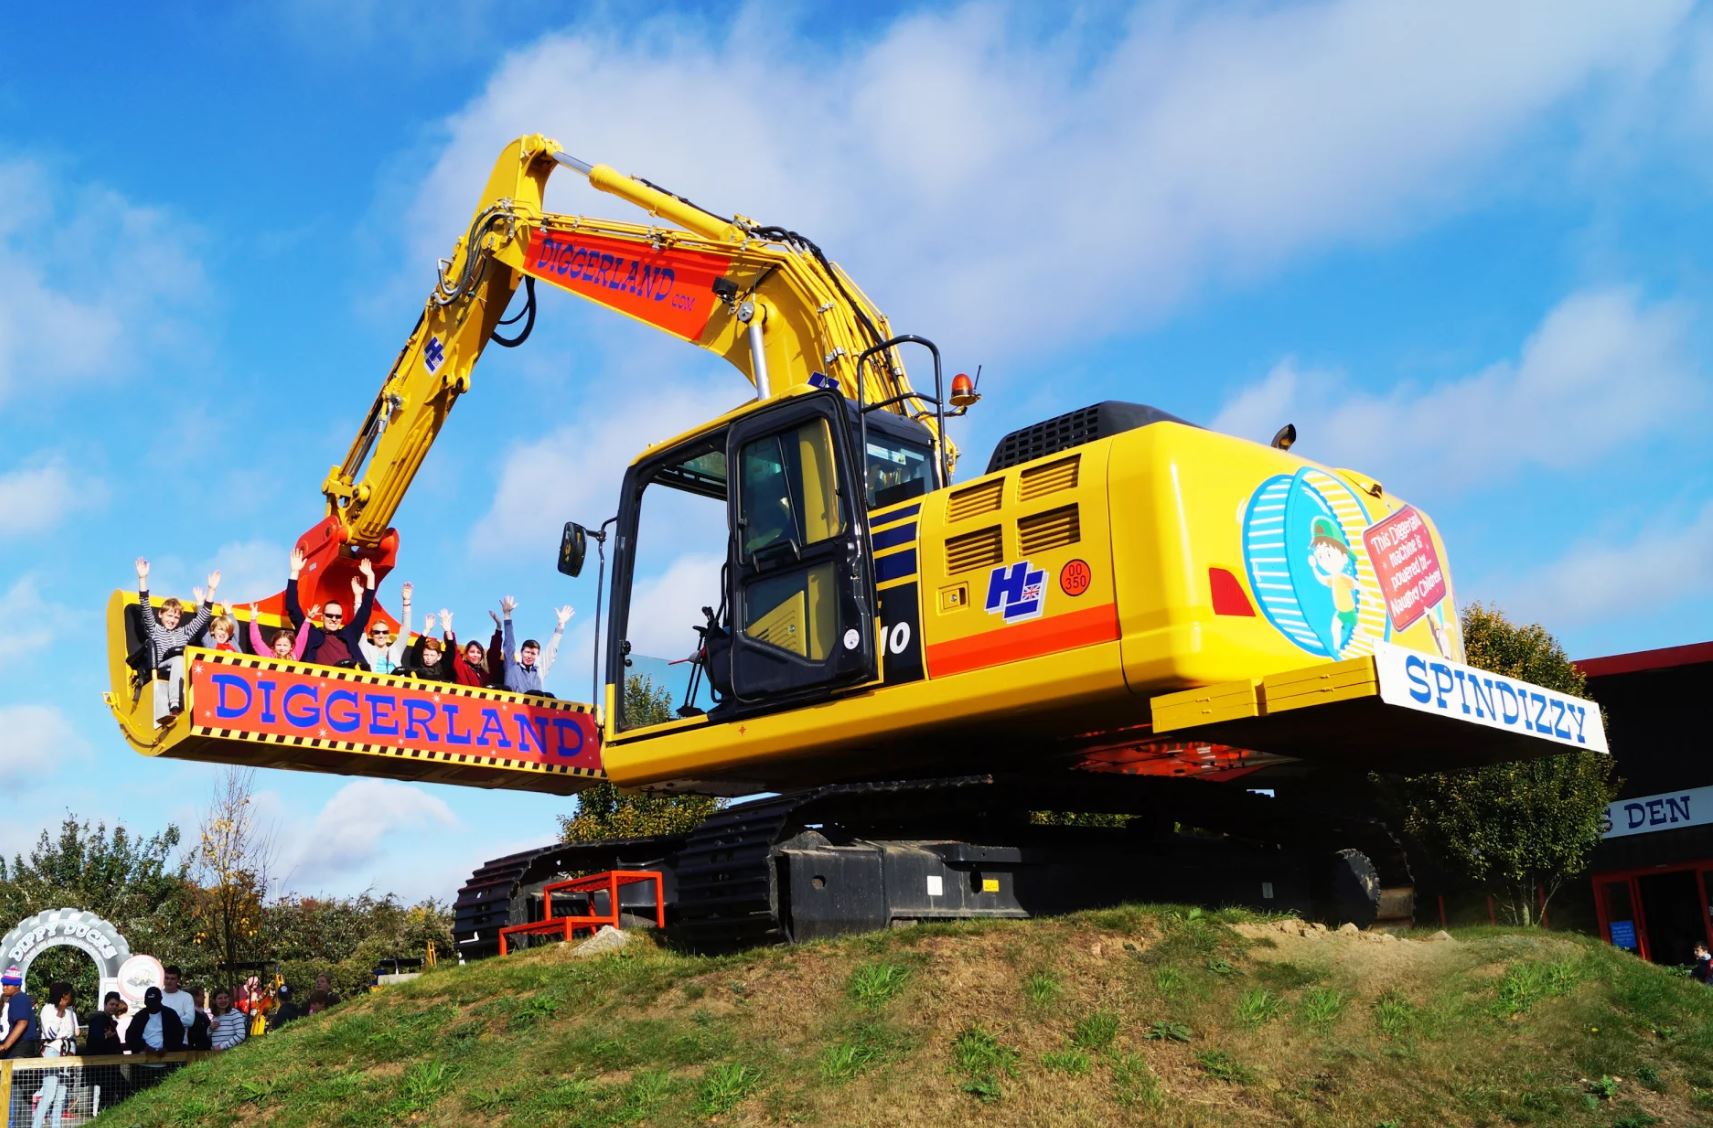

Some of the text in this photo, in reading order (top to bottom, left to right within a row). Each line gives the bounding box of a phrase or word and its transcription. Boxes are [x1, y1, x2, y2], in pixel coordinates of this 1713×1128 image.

[537, 238, 676, 301] DIGGERLAND
[1371, 532, 1391, 554] This
[1413, 534, 1423, 549] is
[1065, 575, 1087, 590] 350
[1391, 557, 1420, 591] powered
[211, 673, 584, 757] DIGGERLAND
[1405, 654, 1586, 744] SPINDIZZY
[1623, 795, 1690, 829] DEN
[64, 919, 118, 959] DUCKS
